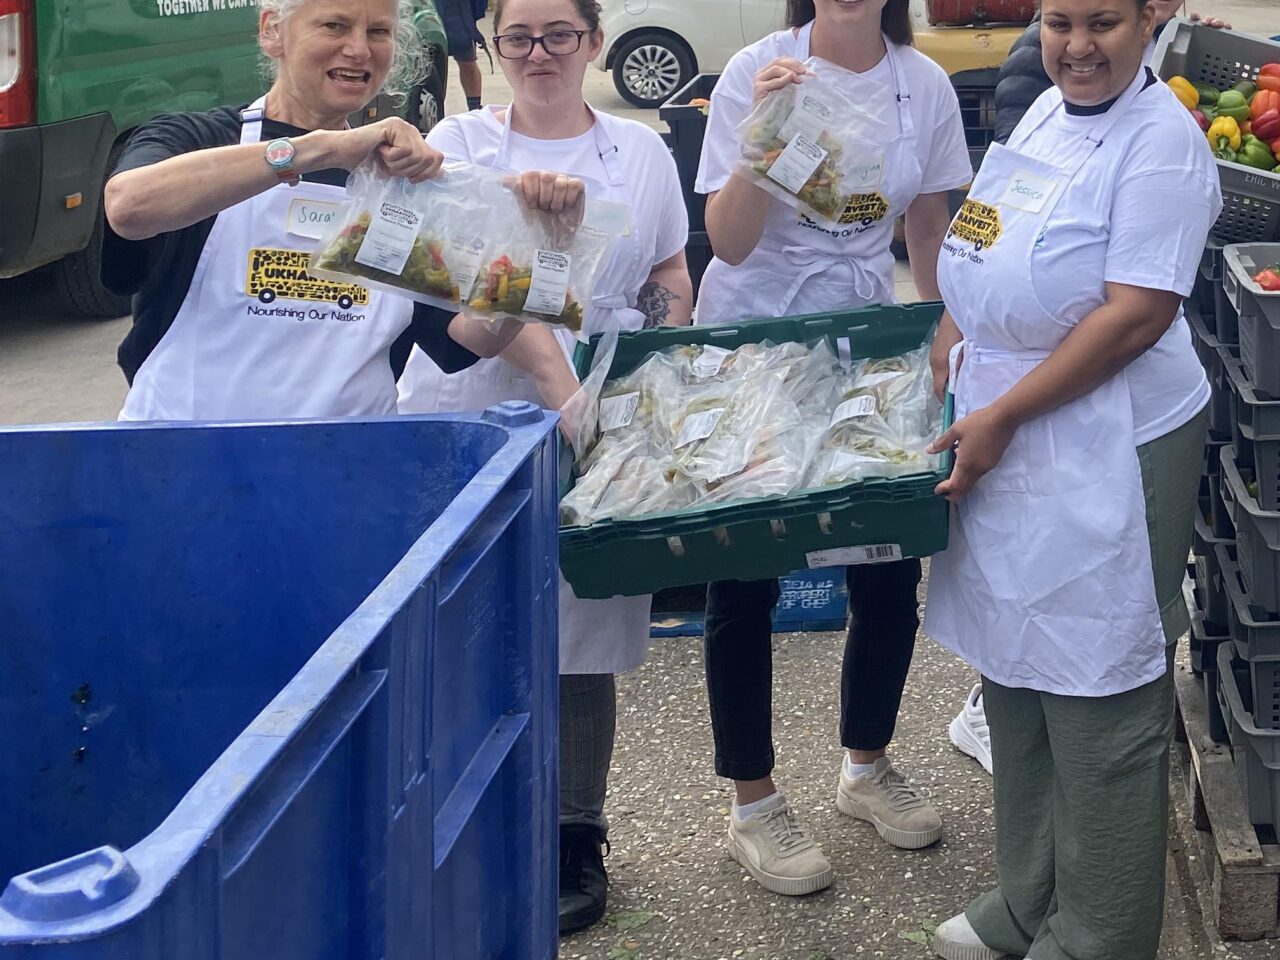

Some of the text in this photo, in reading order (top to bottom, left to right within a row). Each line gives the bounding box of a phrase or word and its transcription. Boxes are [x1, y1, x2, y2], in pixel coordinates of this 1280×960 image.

[1244, 173, 1267, 187] ERIC
[1010, 179, 1044, 200] Jessica
[247, 305, 365, 322] Nourishing Our Nation
